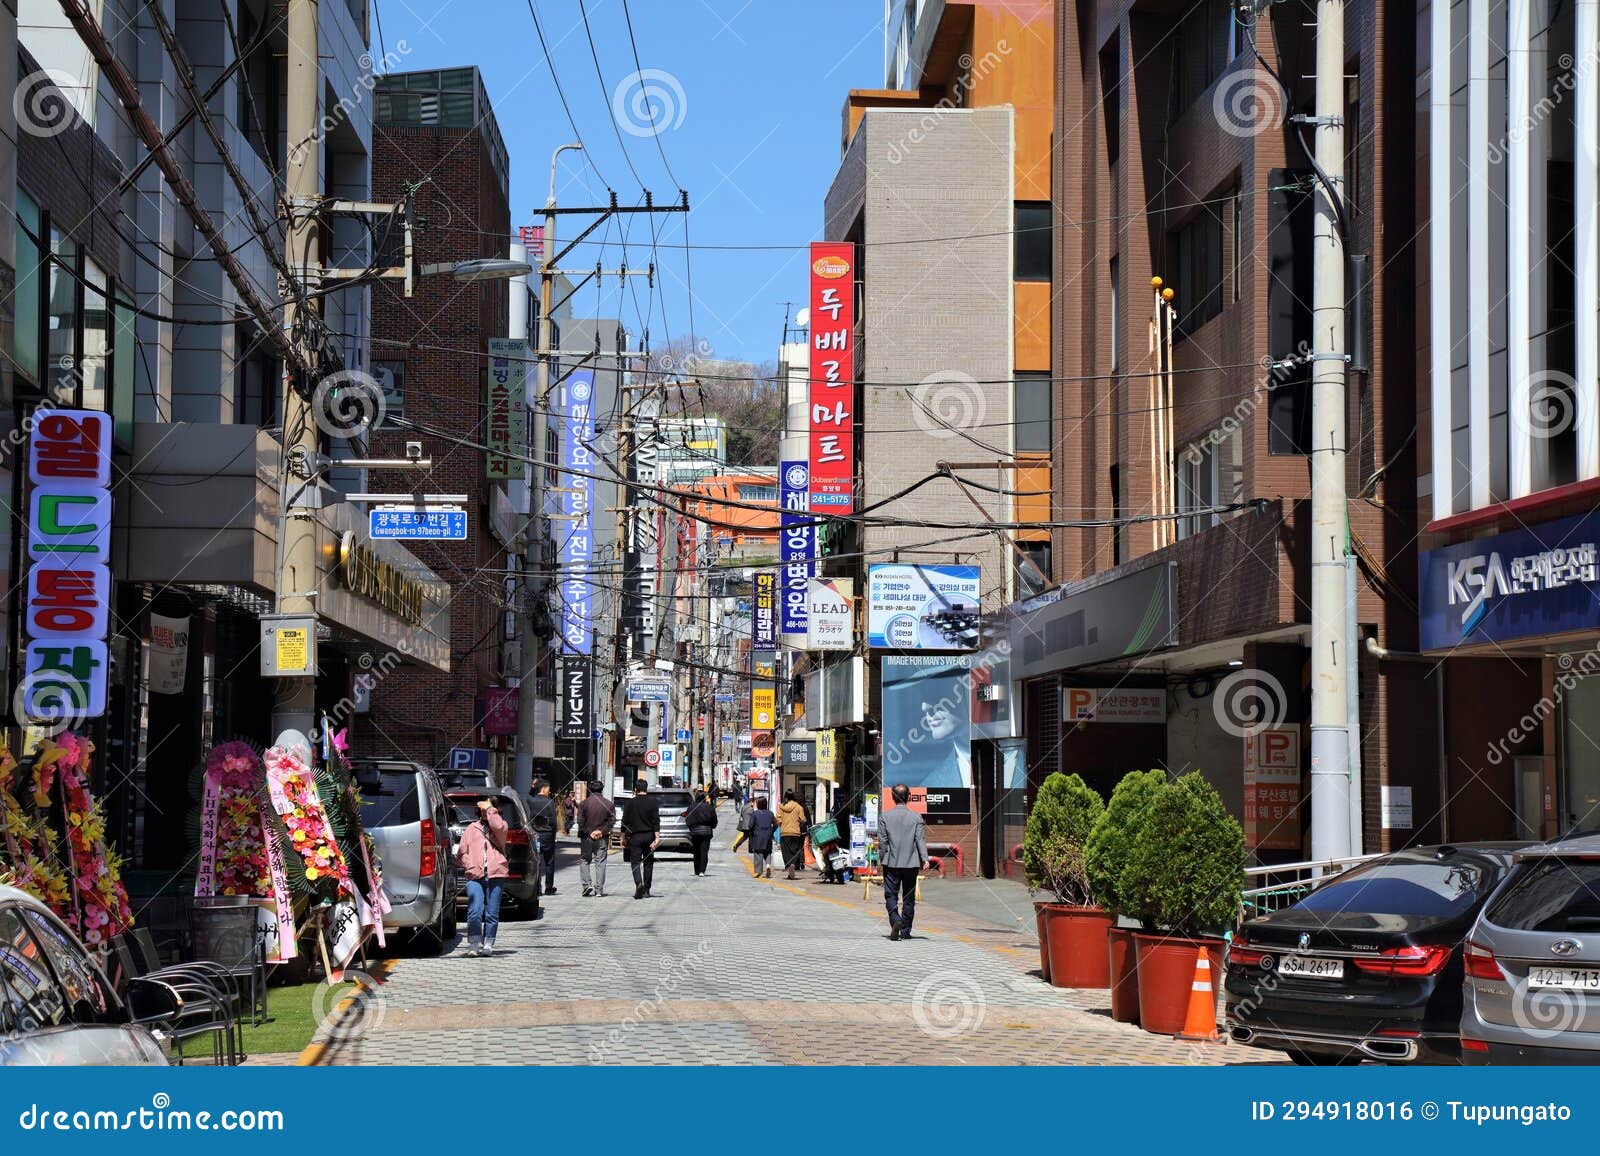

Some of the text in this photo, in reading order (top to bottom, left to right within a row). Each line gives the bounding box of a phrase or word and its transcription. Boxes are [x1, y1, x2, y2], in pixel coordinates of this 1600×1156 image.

[811, 288, 850, 463] 두배로마트
[812, 495, 849, 503] 241-5175
[375, 526, 451, 537] Gwangbok-ro 97beon-gil
[1510, 543, 1598, 594] 한국해운조합
[882, 593, 911, 601] 세미나실
[1447, 551, 1511, 632] KSA
[812, 603, 849, 614] LEAD
[818, 626, 843, 634] カラオケ
[887, 656, 966, 666] IMAGE FOR MAN'S WEAR
[567, 671, 584, 725] ZEUS
[1069, 689, 1092, 720] P
[790, 743, 808, 752] 이마트
[1265, 734, 1290, 764] P
[454, 751, 471, 769] P
[663, 751, 671, 760] P
[790, 753, 808, 762] 편의점
[1258, 789, 1299, 803] 부산호텔
[1308, 960, 1339, 976] 2617
